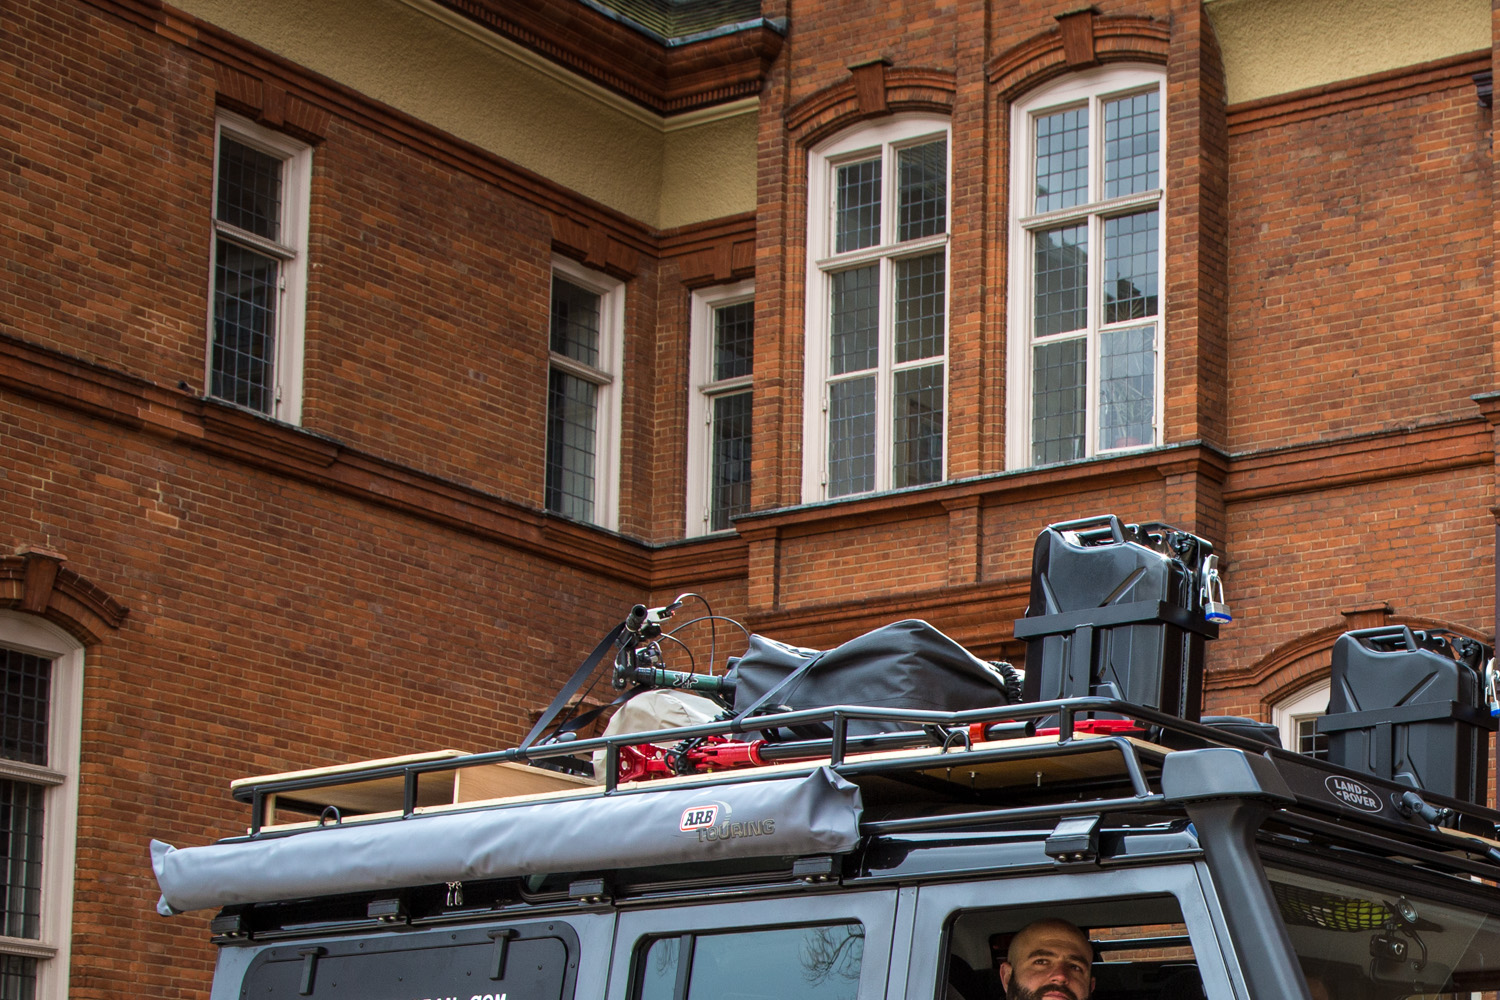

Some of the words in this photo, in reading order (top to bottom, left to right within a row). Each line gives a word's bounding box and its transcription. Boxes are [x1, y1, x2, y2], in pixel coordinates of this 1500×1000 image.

[1333, 778, 1362, 795] LAND
[1343, 791, 1377, 808] ROVER
[684, 810, 714, 827] ARB
[696, 818, 776, 842] TOURING
